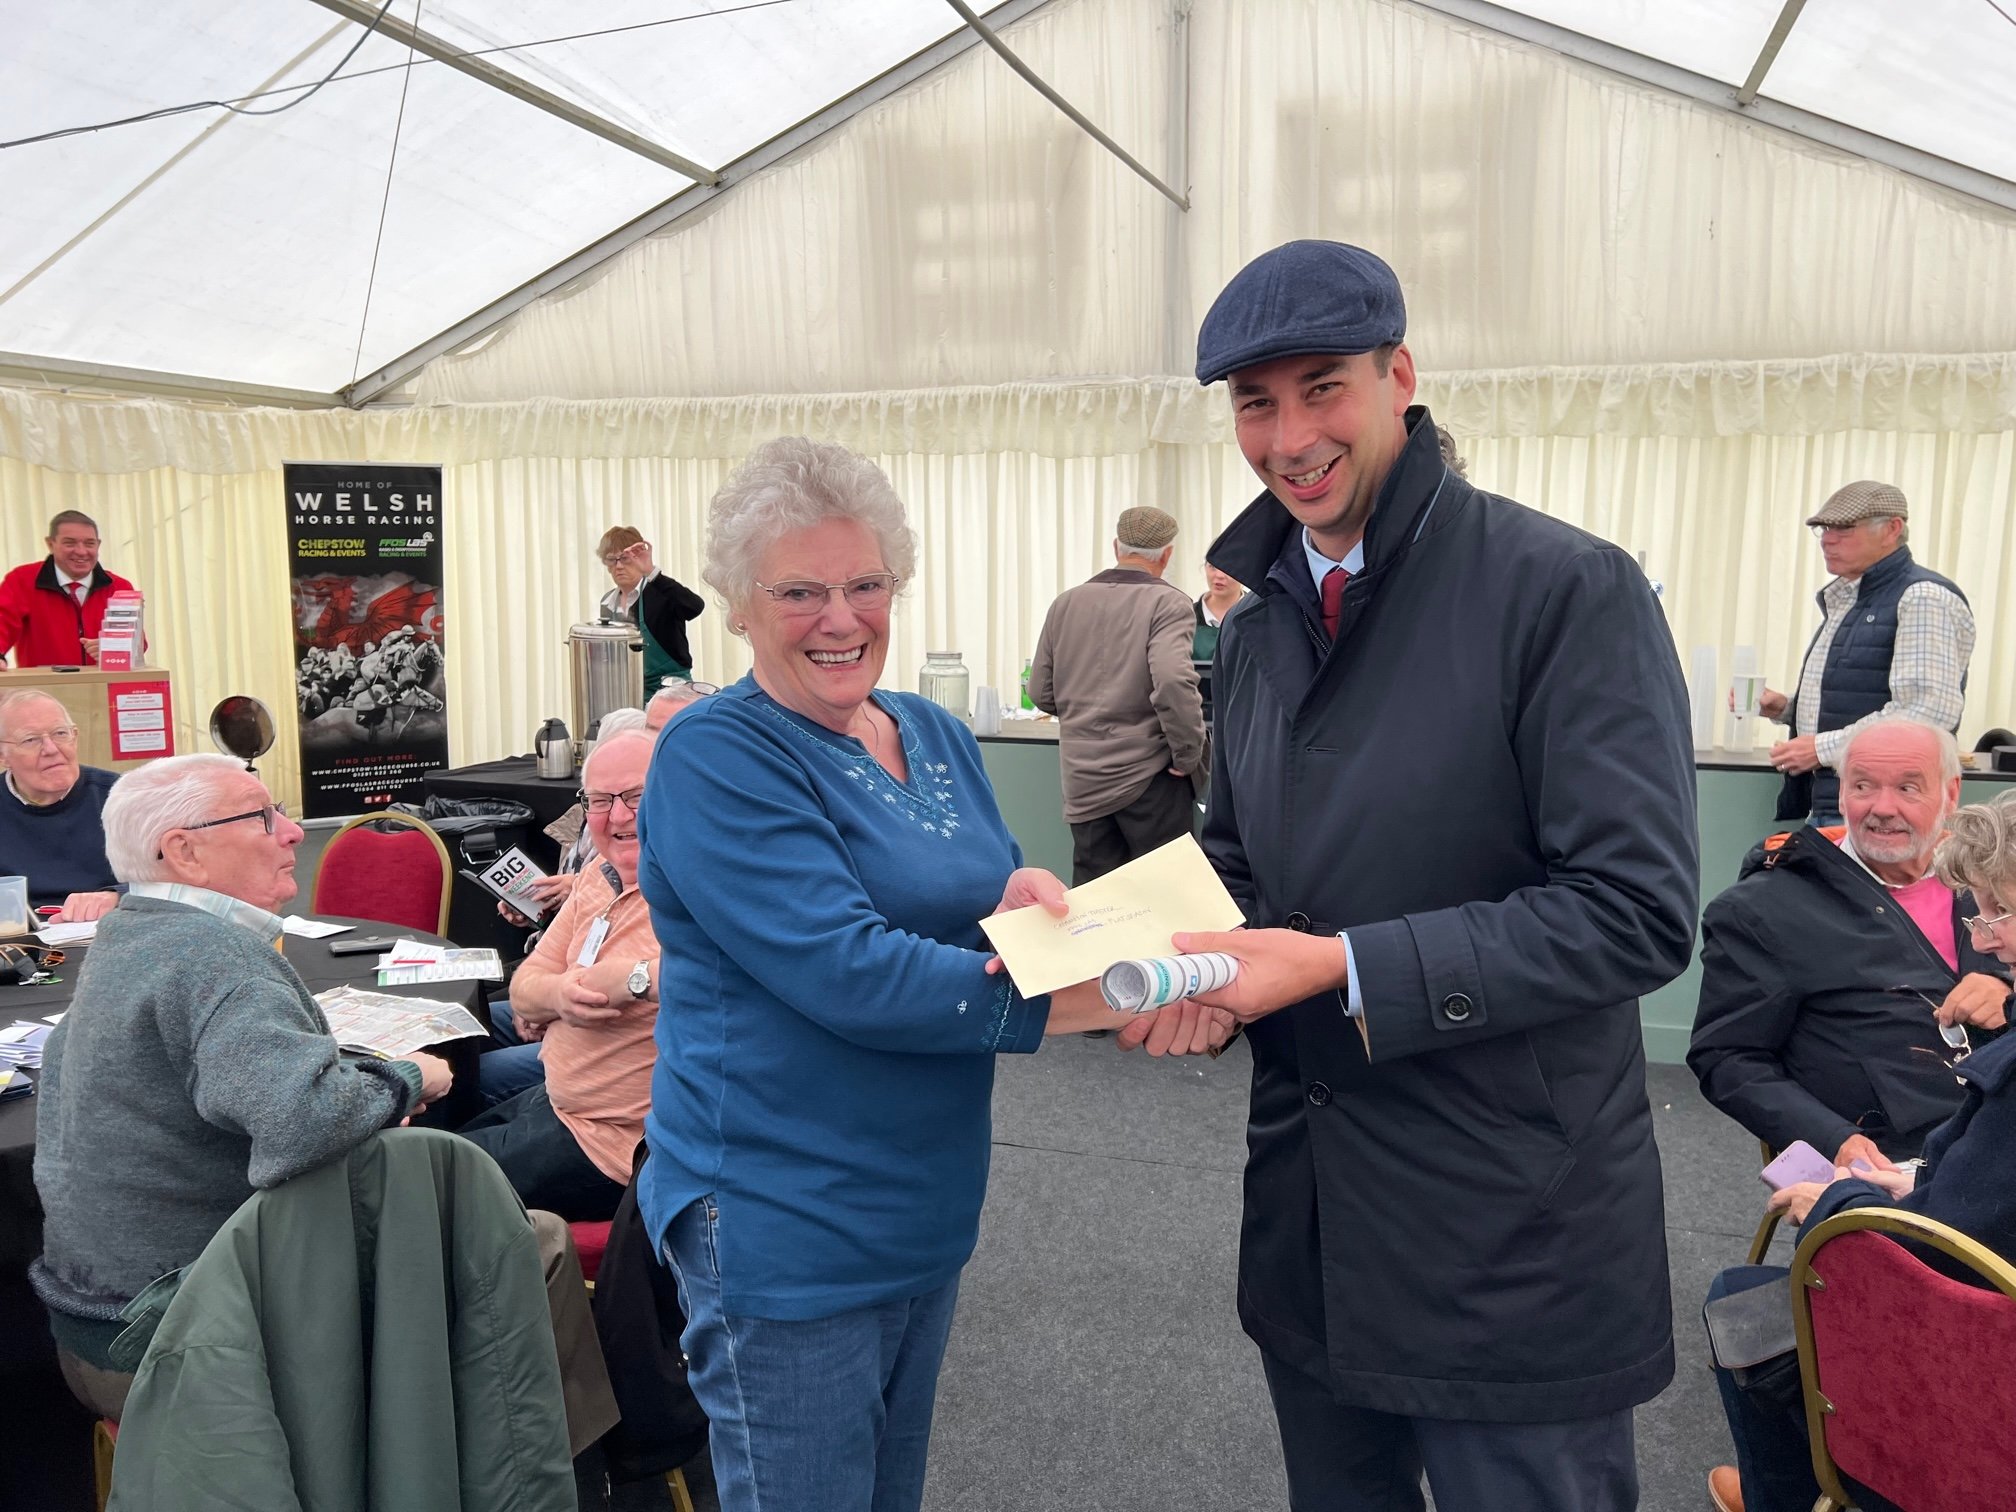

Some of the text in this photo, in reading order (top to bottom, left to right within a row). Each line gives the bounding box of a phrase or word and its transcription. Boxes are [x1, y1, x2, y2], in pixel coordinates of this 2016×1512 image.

[337, 481, 371, 489] HOME
[294, 492, 433, 512] WELSH
[295, 515, 435, 525] HORSE RACING
[298, 539, 365, 549] CHEPSTOW
[298, 549, 329, 557] RACING
[336, 549, 366, 557] EVENTS
[335, 757, 359, 765] FIND
[387, 754, 417, 762] MORE:
[320, 777, 424, 790] WWW.FFOSLASRACECOURSE.C
[507, 871, 536, 895] WEEKEND
